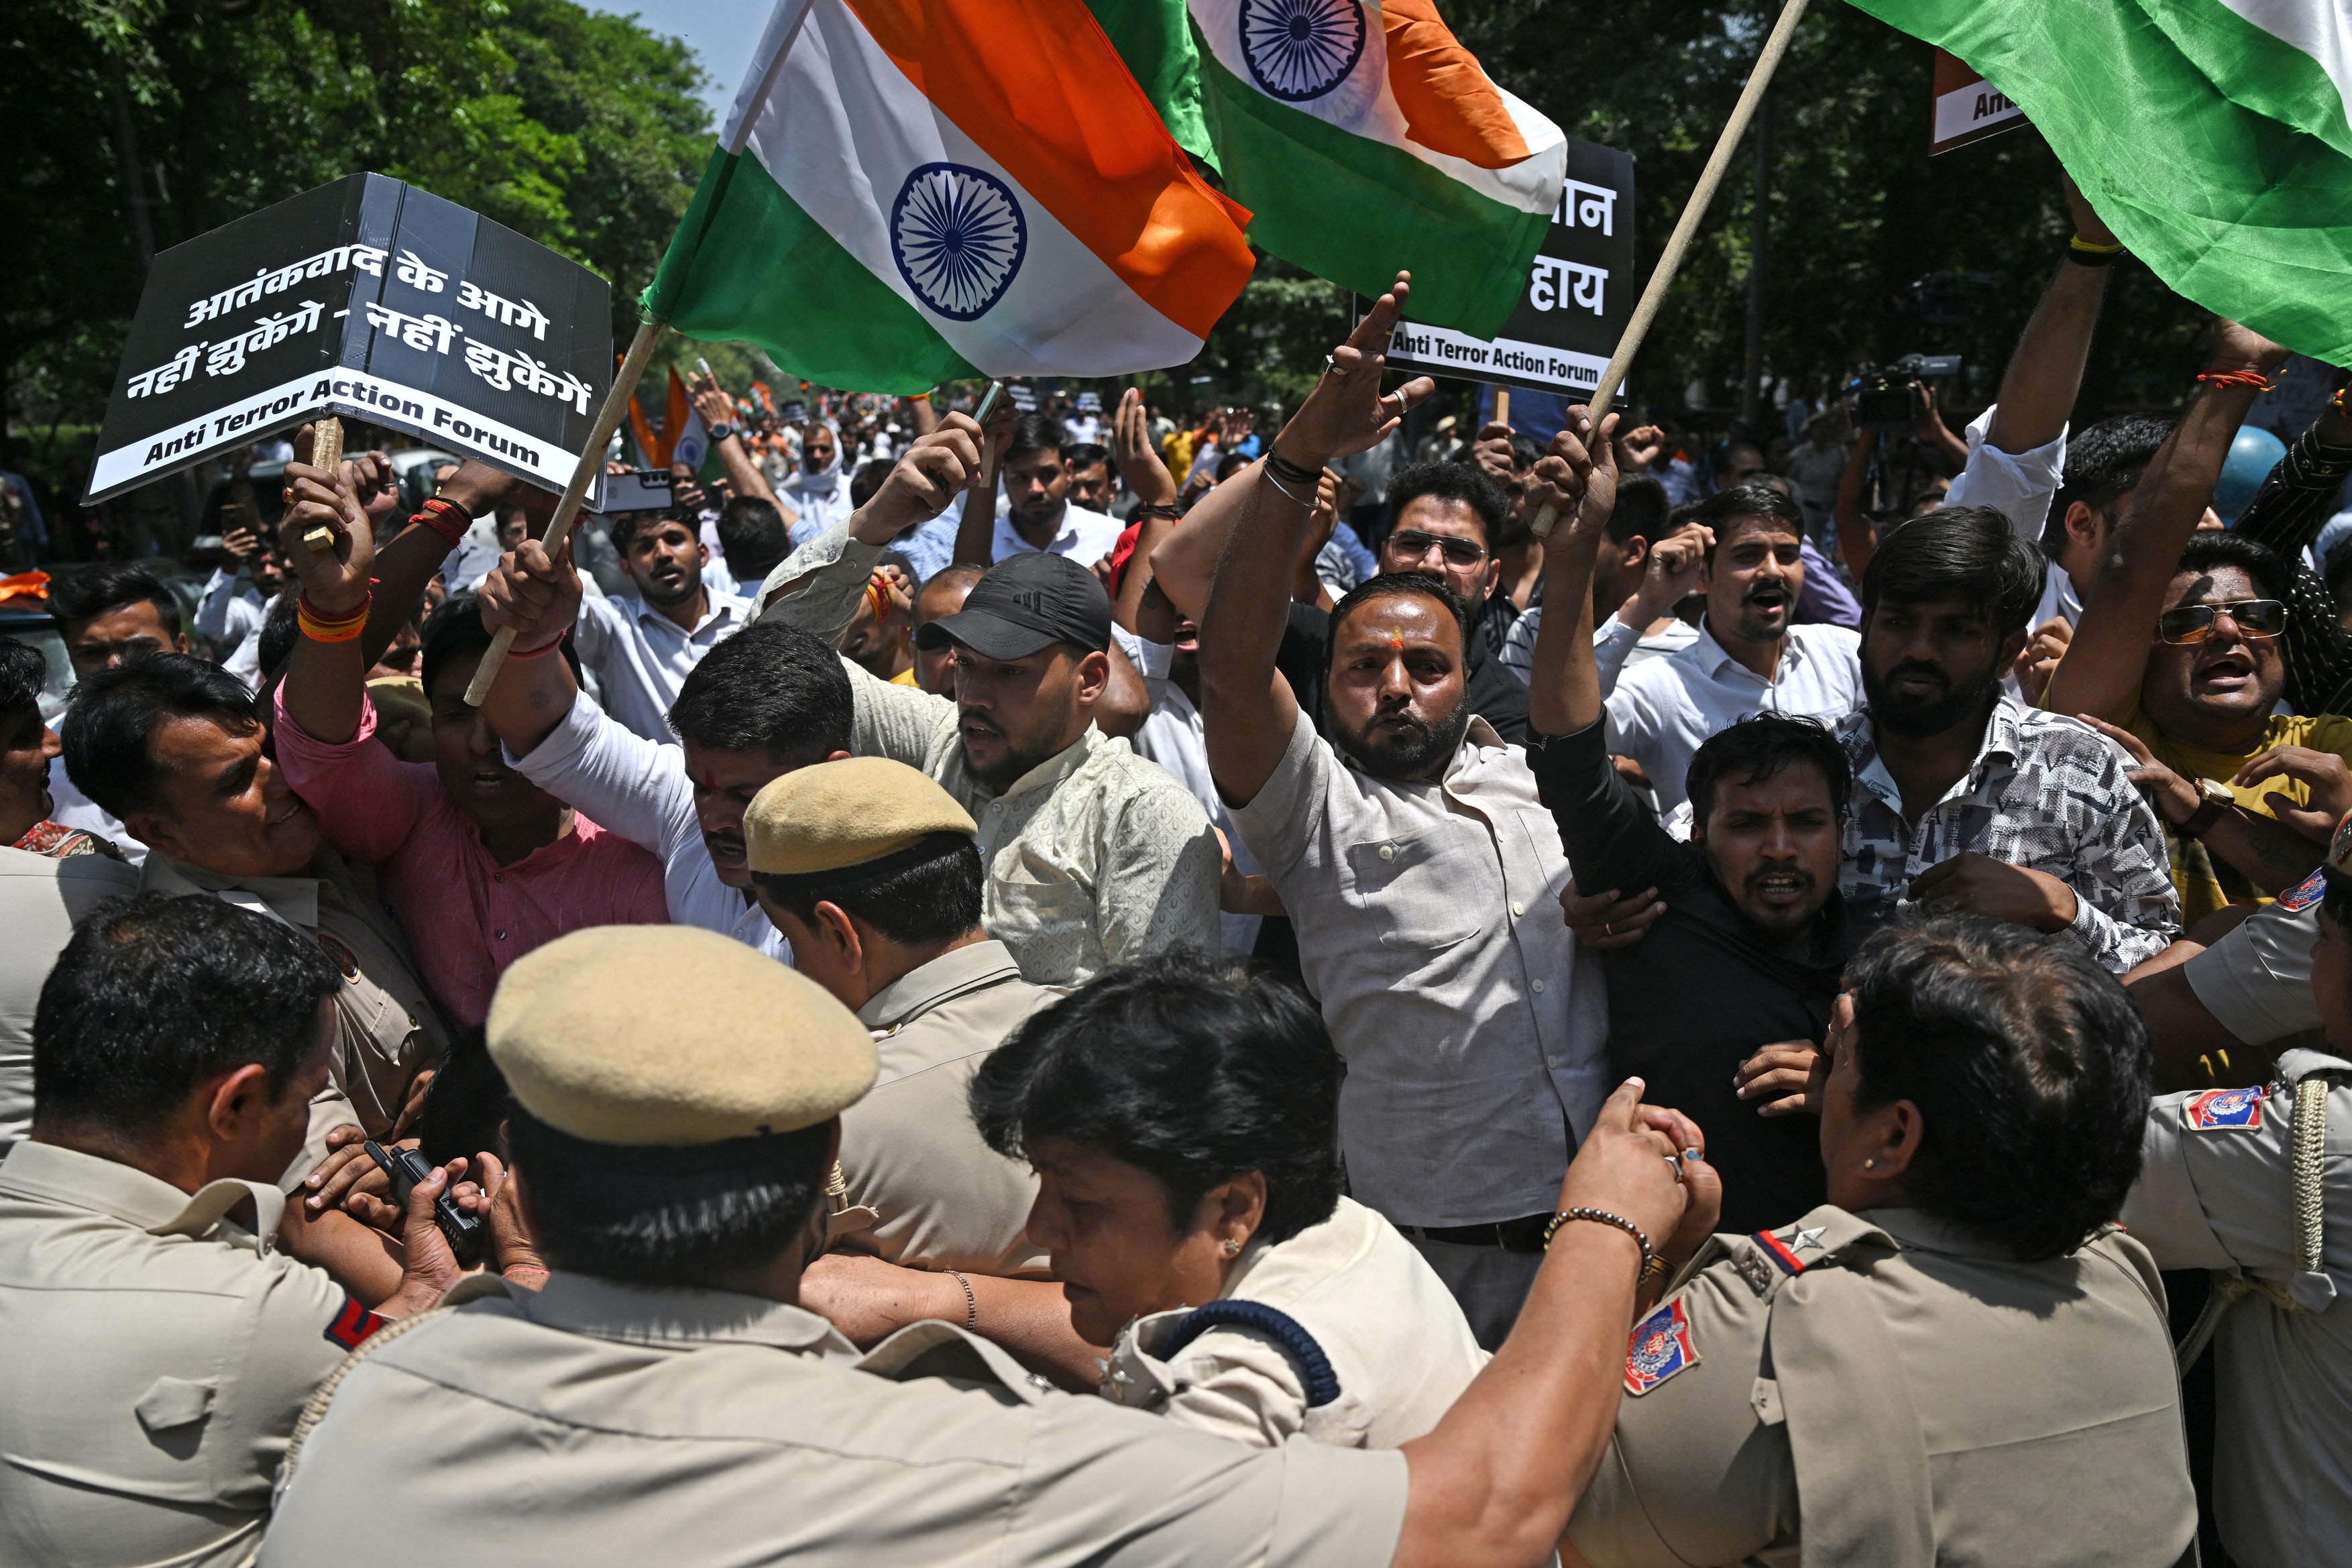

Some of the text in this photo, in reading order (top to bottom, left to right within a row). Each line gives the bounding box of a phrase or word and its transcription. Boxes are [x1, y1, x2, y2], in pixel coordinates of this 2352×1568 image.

[184, 243, 550, 341] आतंकवाद के आगे
[1529, 254, 1609, 317] हाय
[127, 341, 209, 399] नहीं
[206, 300, 325, 377] झुकेंगे
[366, 302, 463, 355] नहीं
[1392, 331, 1598, 384] Anti Terror Action Forum
[144, 379, 540, 467] Anti Terror Action Forum
